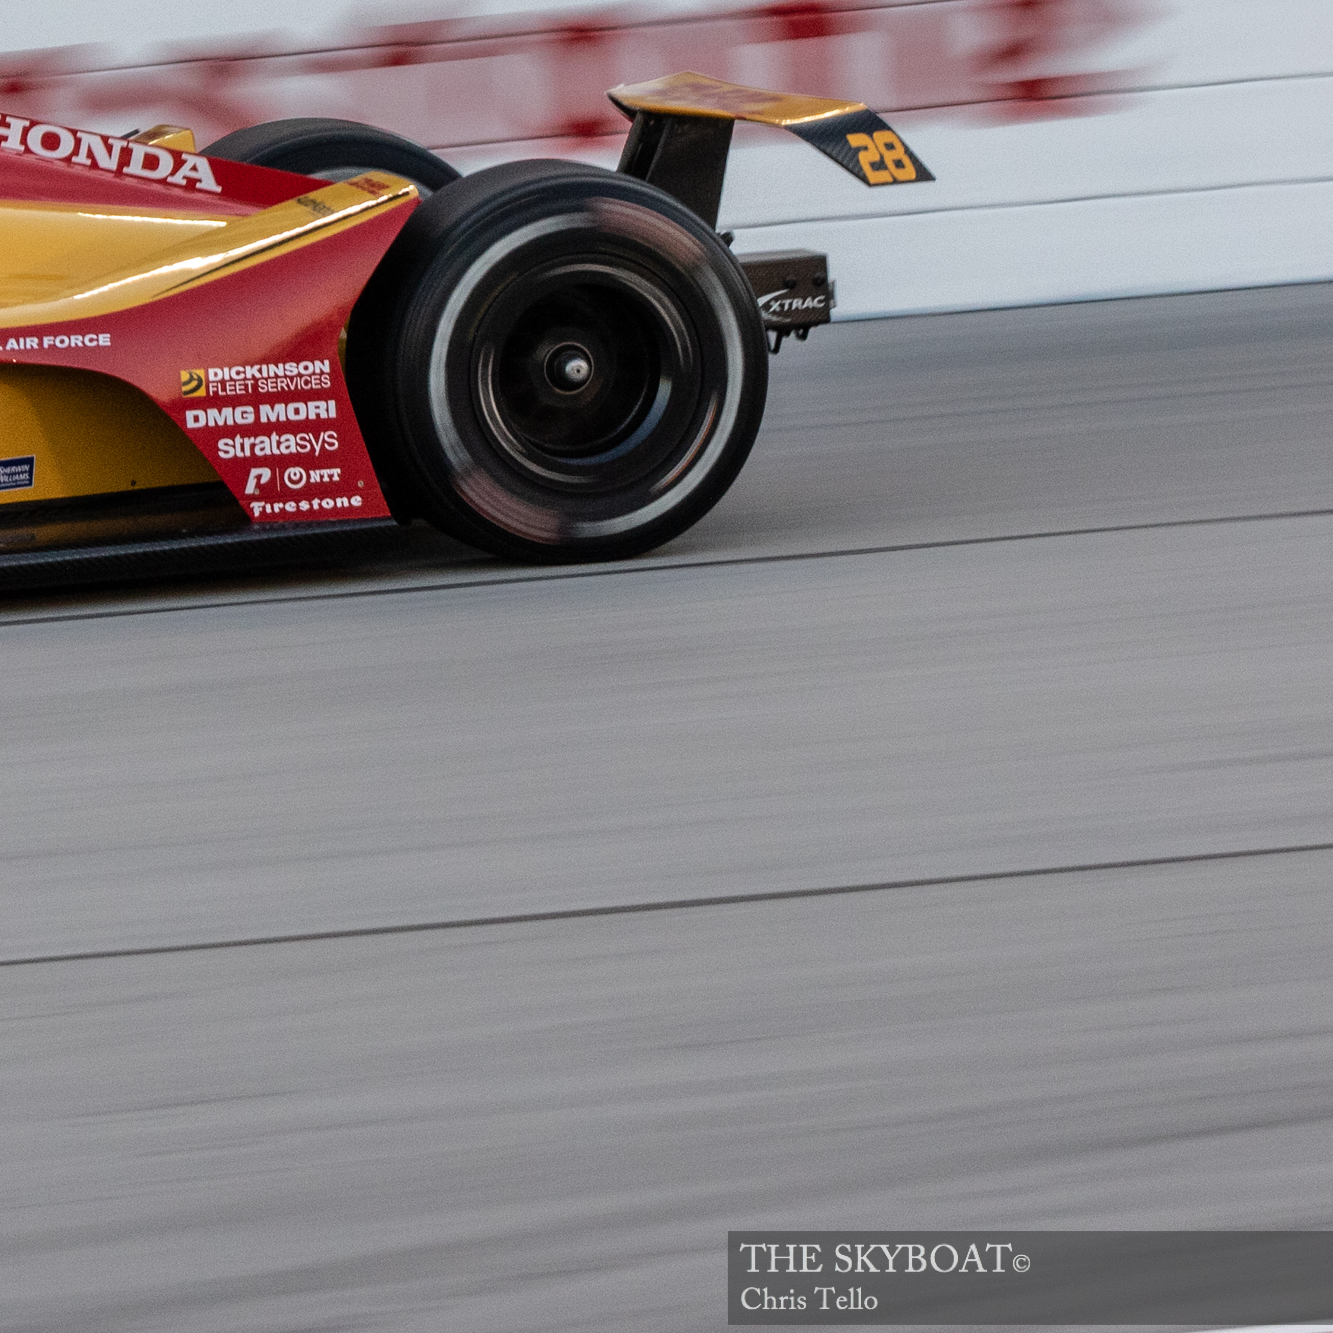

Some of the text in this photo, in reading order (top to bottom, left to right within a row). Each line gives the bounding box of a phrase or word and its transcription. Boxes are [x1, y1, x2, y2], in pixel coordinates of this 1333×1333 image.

[845, 130, 916, 185] 28
[767, 294, 827, 314] XTRAC
[6, 336, 39, 351] AIR
[42, 333, 111, 349] FORCE
[207, 359, 331, 382] DICKINSON
[209, 374, 331, 396] FLEET SERVICES
[185, 399, 337, 429] DMG MORI
[217, 430, 339, 459] stratasys
[309, 468, 342, 484] NTT
[249, 494, 363, 518] Firestone
